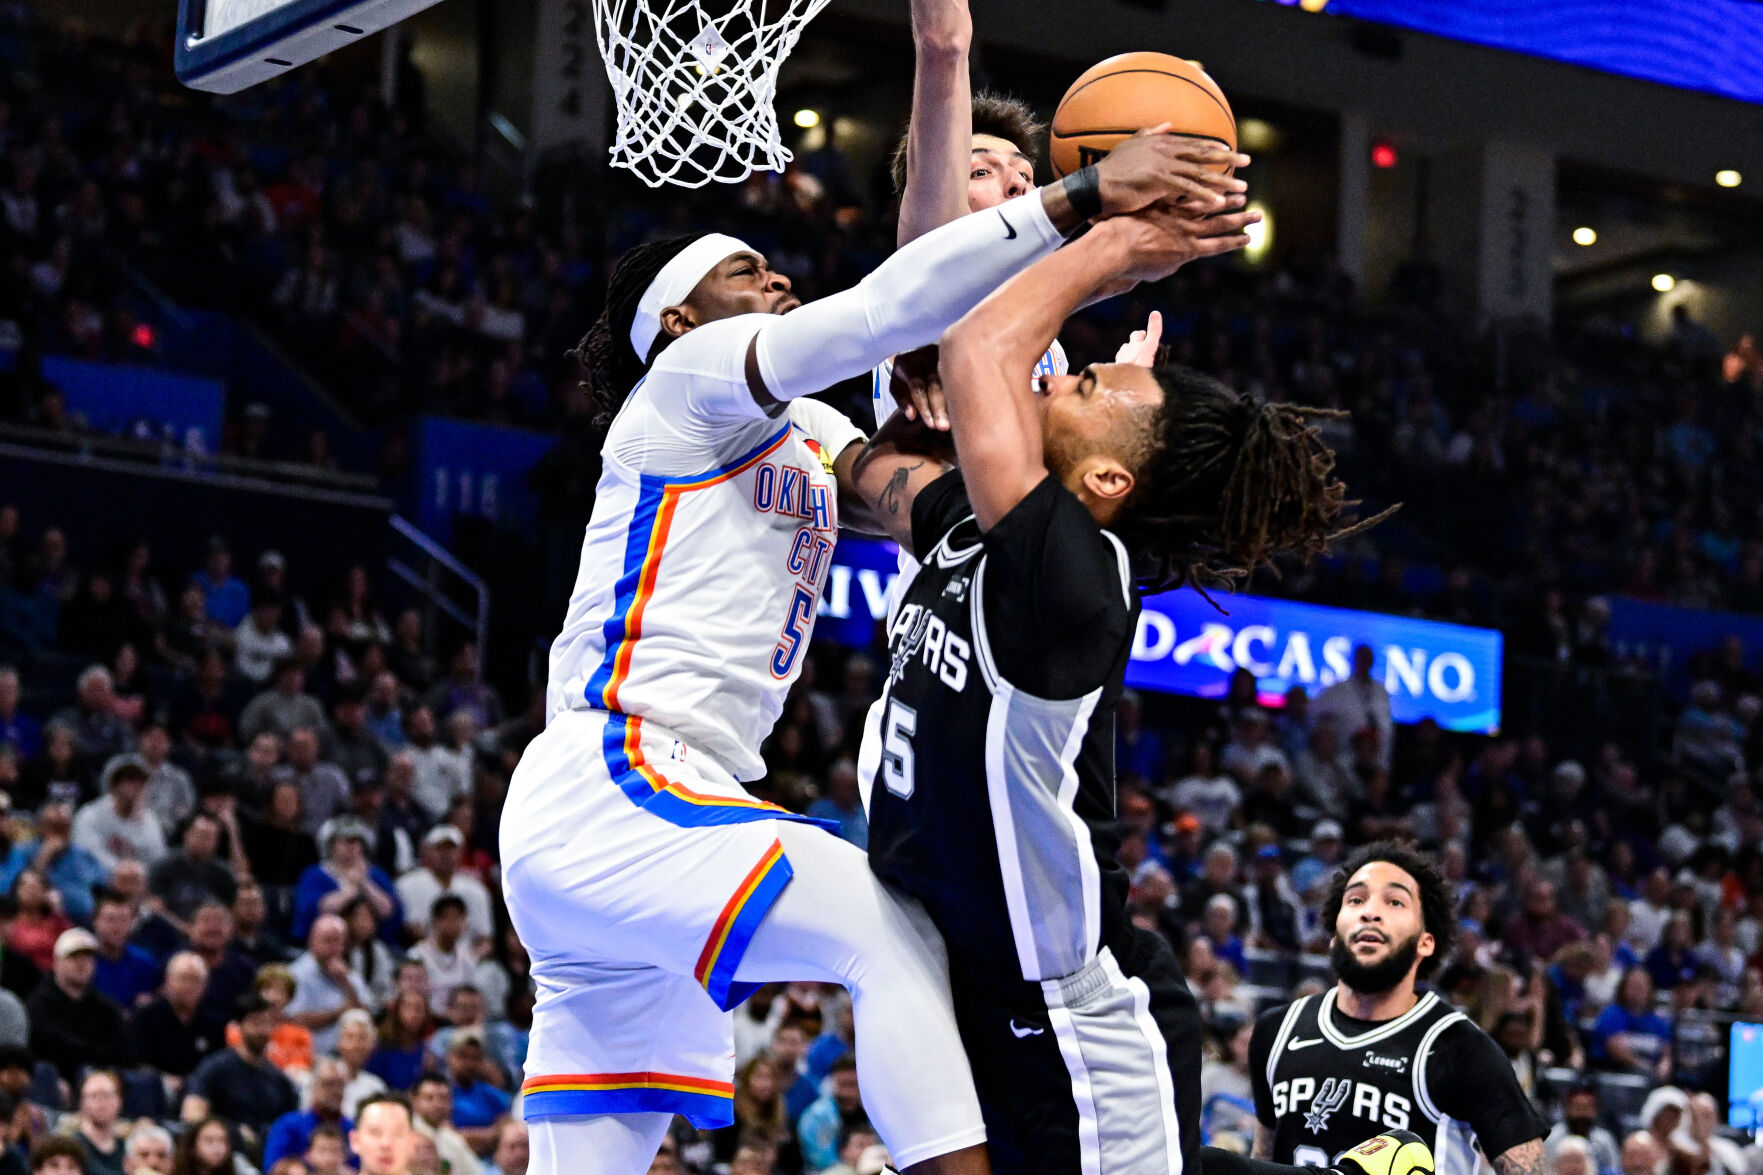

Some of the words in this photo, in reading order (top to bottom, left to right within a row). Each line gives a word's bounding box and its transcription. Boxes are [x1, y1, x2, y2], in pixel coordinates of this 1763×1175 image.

[770, 582, 815, 680] 5
[888, 603, 971, 692] PURS
[1233, 625, 1477, 703] CASNO
[882, 696, 918, 801] 5
[1272, 1076, 1412, 1136] SPURS
